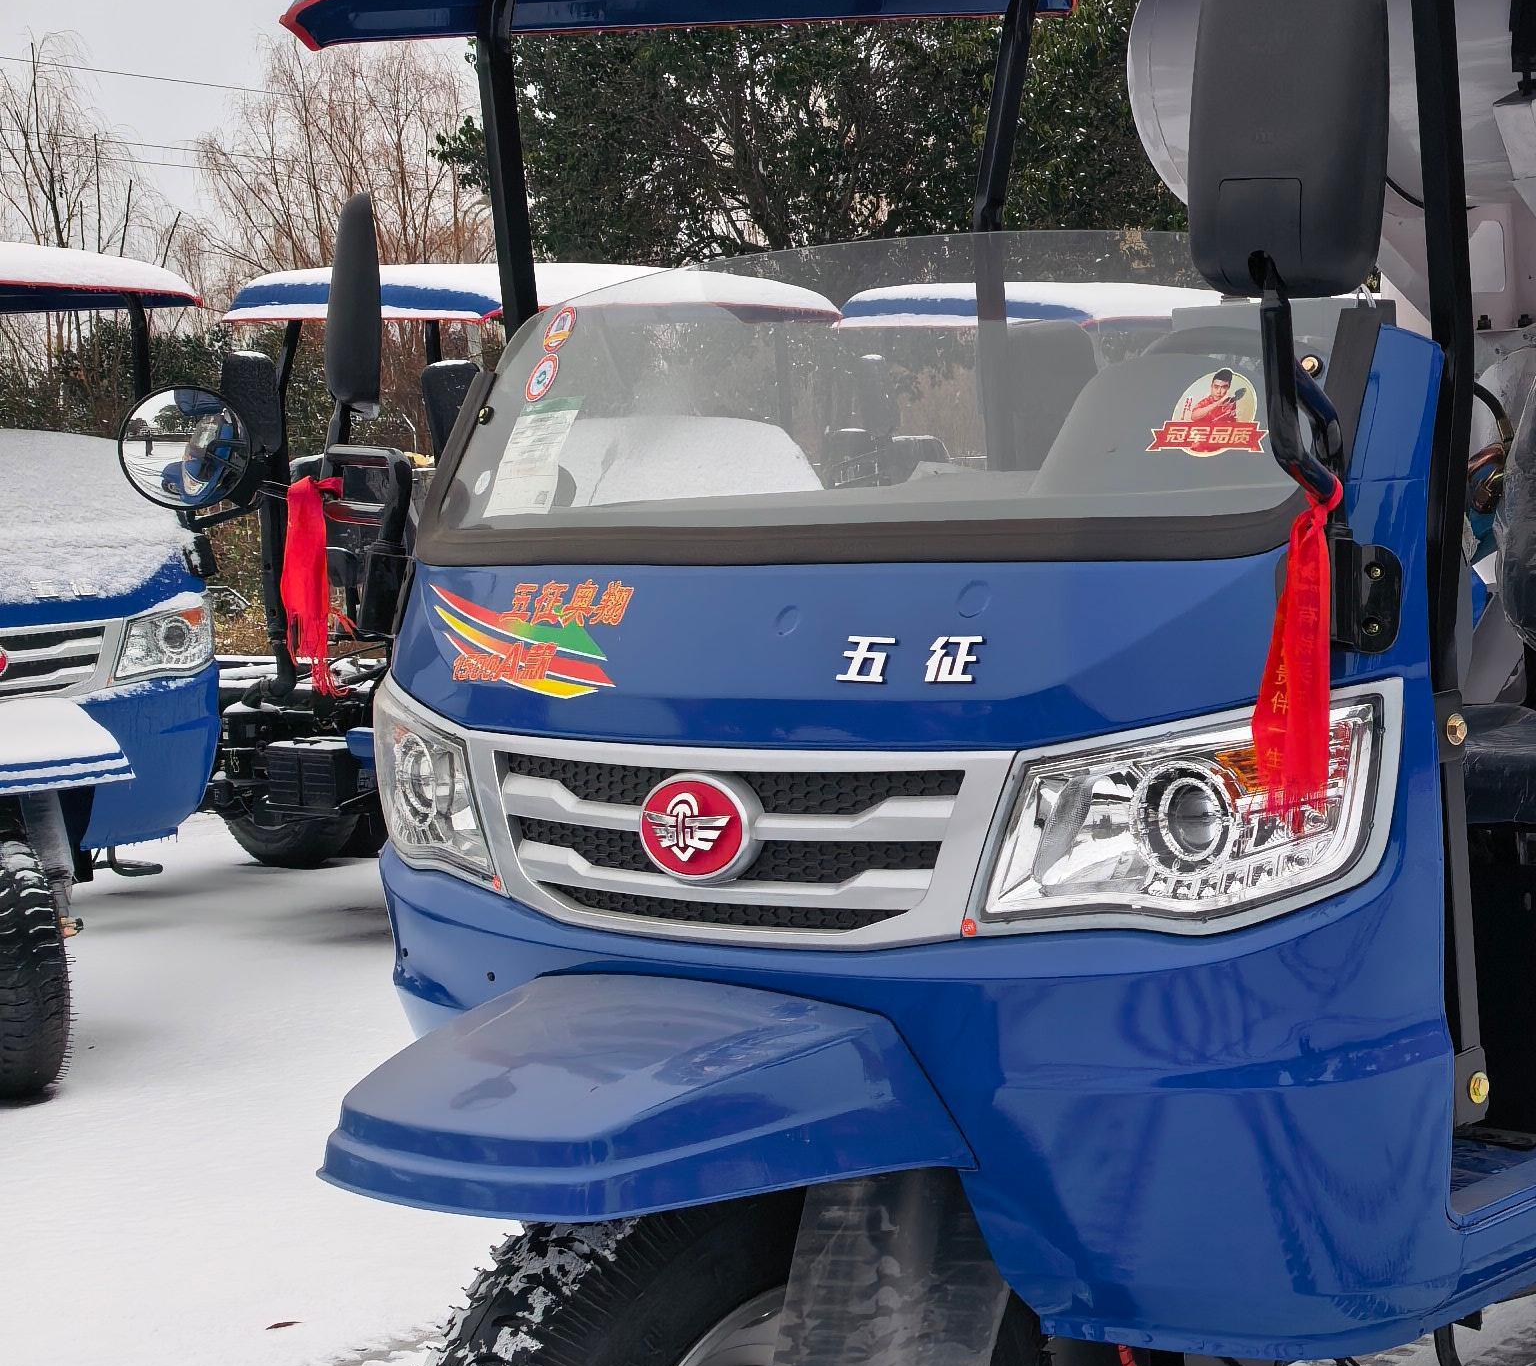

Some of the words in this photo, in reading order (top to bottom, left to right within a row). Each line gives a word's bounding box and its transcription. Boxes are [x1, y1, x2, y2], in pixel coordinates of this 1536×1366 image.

[1166, 426, 1253, 444] 冠军品质
[499, 579, 634, 627] 五征奥翔
[836, 634, 984, 683] 五征
